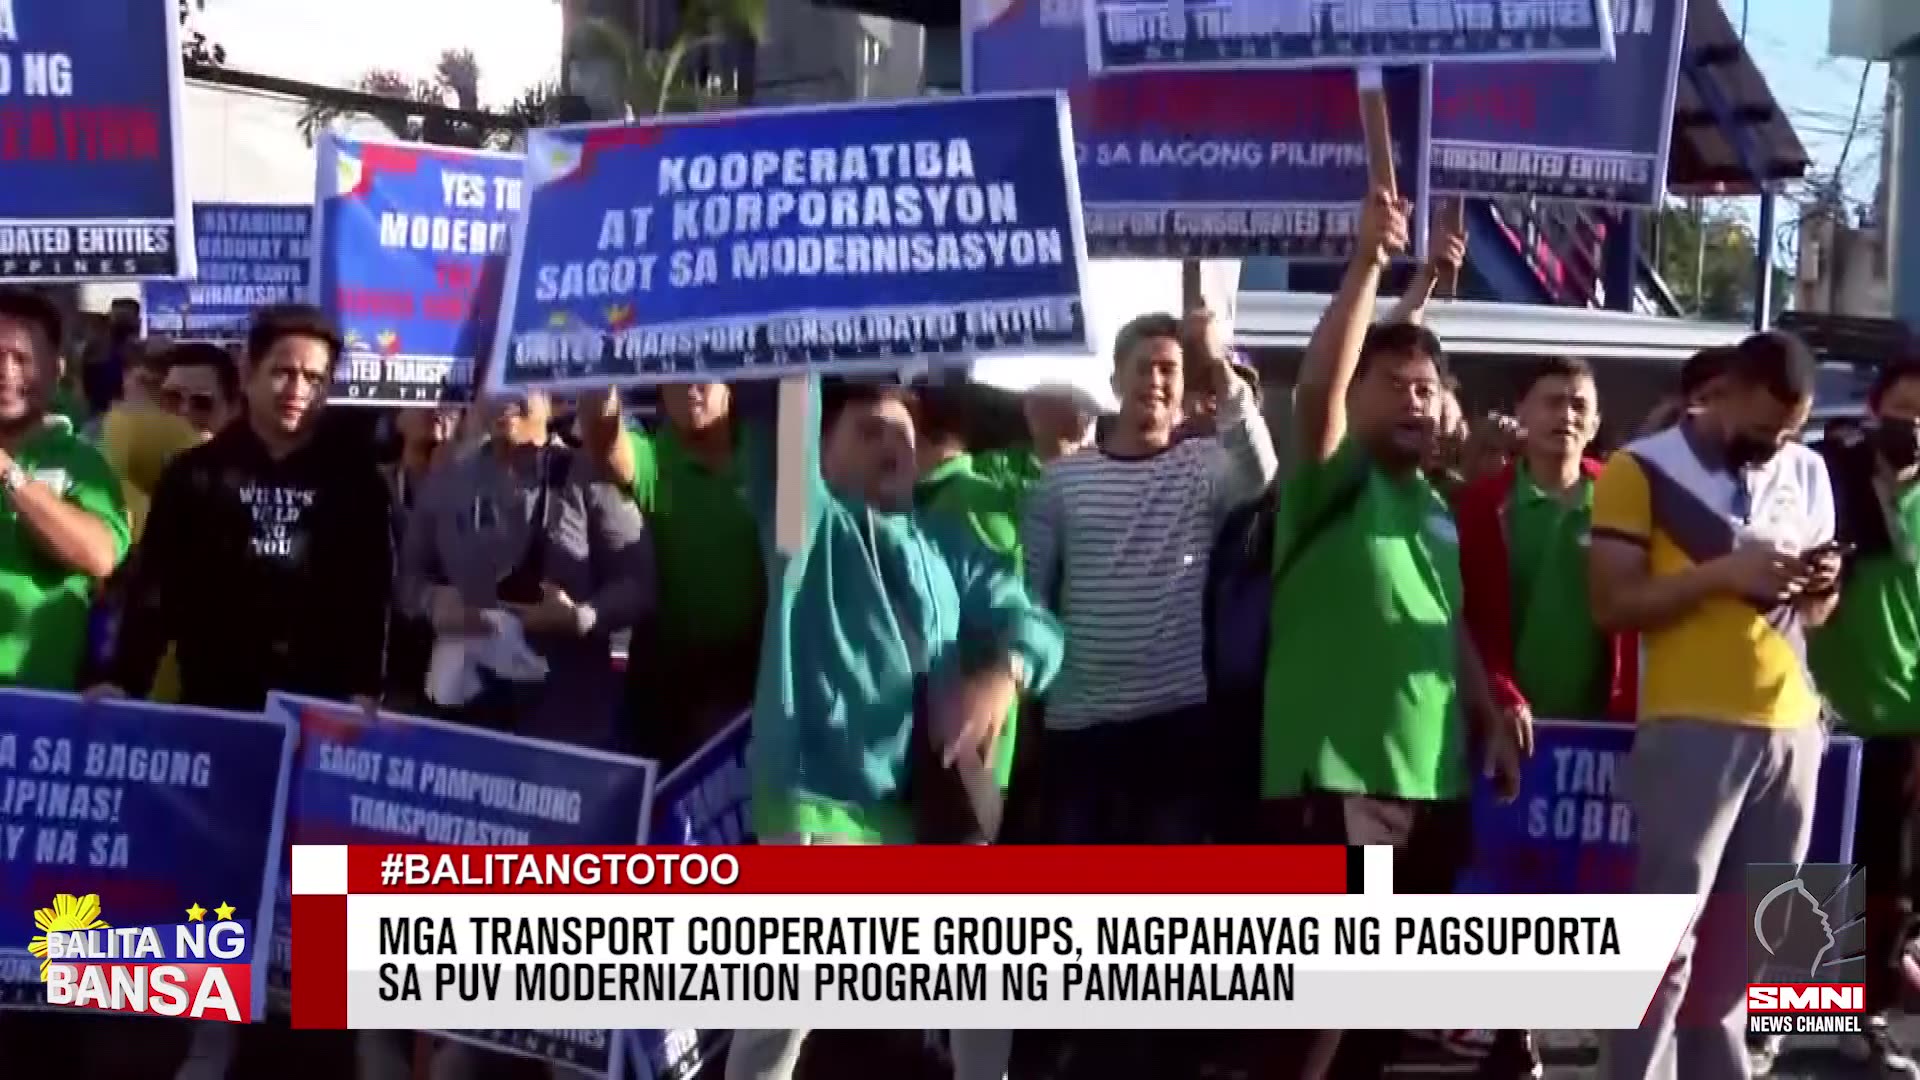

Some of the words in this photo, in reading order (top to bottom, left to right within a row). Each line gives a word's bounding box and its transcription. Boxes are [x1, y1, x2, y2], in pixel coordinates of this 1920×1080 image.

[23, 52, 73, 97] NG
[658, 138, 975, 195] KOOPERATIBA
[1139, 142, 1263, 168] BAGONG
[441, 169, 486, 209] YES
[597, 206, 654, 250] AT
[672, 182, 1018, 239] KORPORASYON
[77, 227, 170, 255] ENTITIES
[535, 253, 660, 301] SAGOT
[670, 251, 718, 288] SA
[731, 227, 1064, 280] MODERNISASYON
[29, 736, 72, 775] SA
[84, 742, 211, 788] BAGONG
[36, 828, 78, 865] NA
[89, 833, 129, 869] SA
